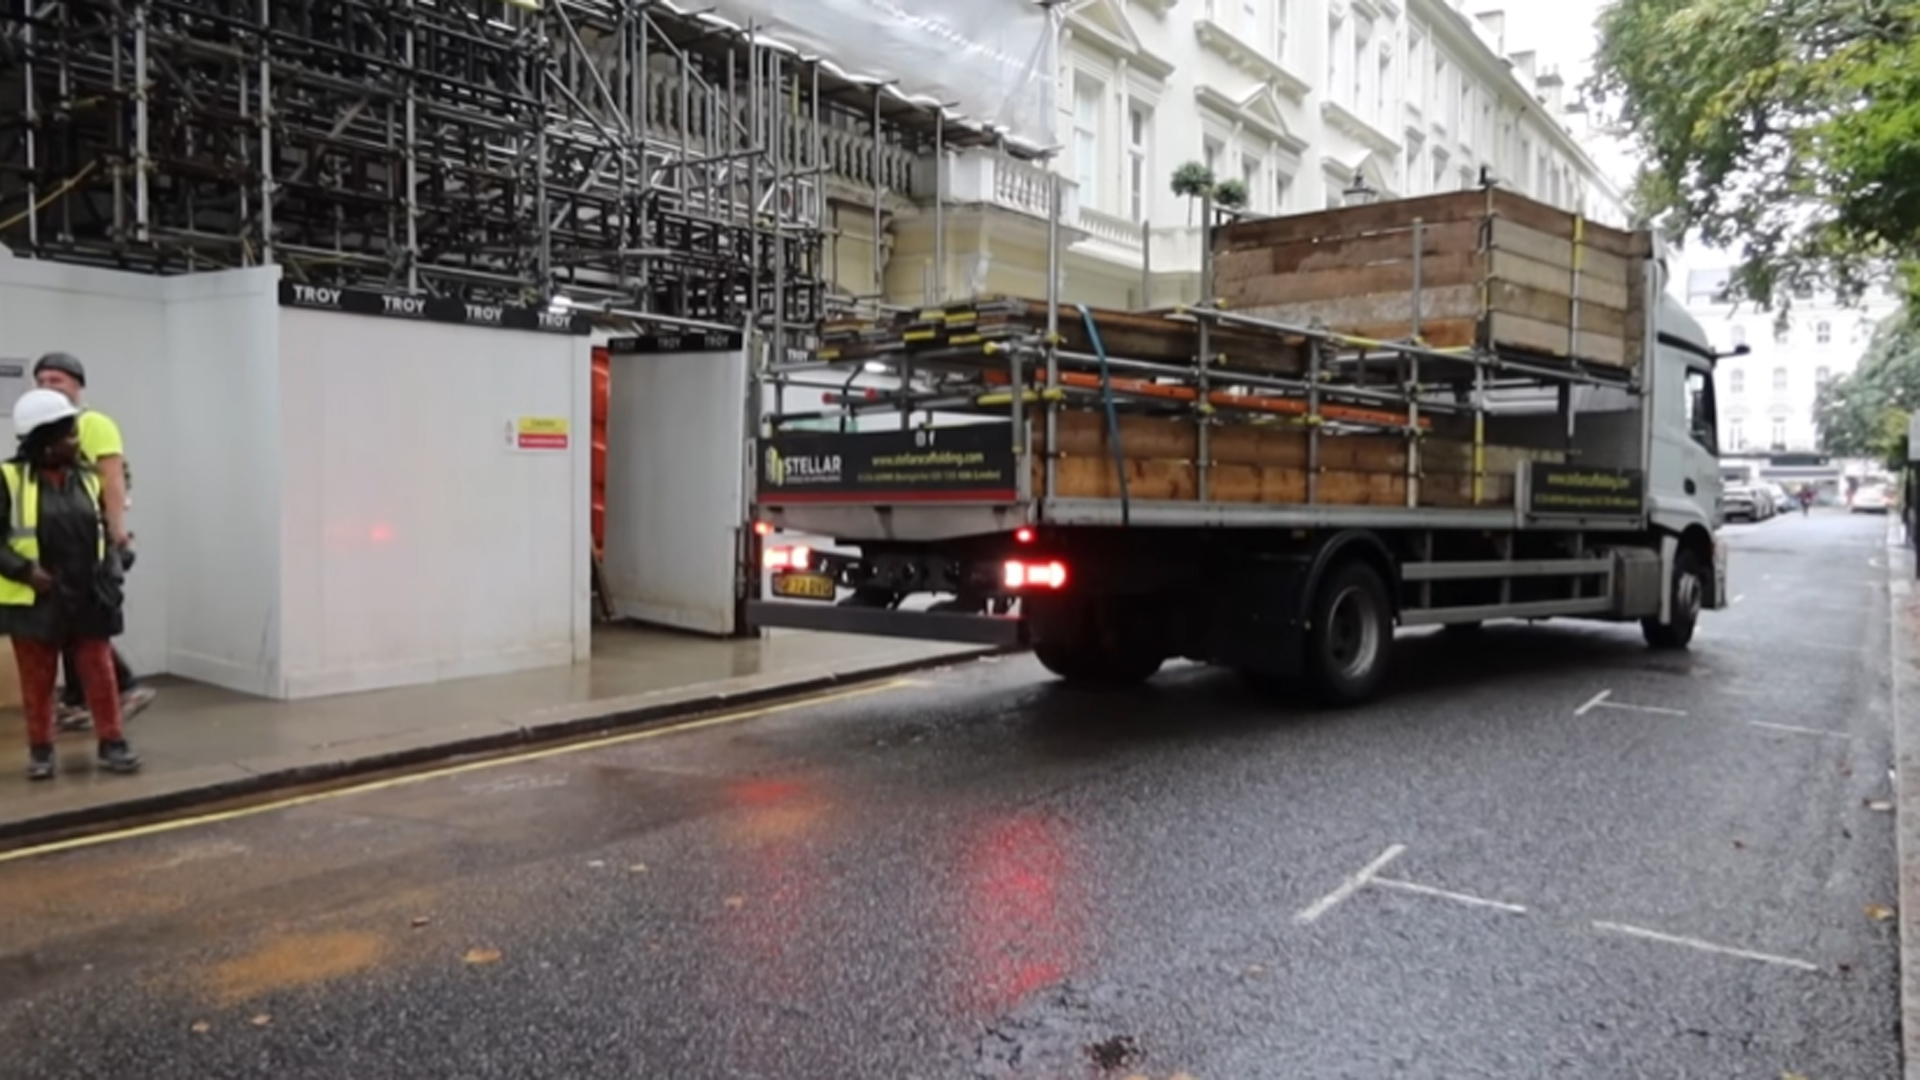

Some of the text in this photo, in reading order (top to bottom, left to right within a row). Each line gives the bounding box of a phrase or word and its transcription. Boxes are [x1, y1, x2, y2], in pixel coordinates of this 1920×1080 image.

[293, 284, 342, 305] TROY
[382, 295, 426, 314] TROY
[465, 304, 503, 321] TROY
[537, 312, 572, 328] TROY
[657, 337, 681, 348] TROY
[704, 335, 730, 347] TROY
[785, 455, 842, 475] STELLAR
